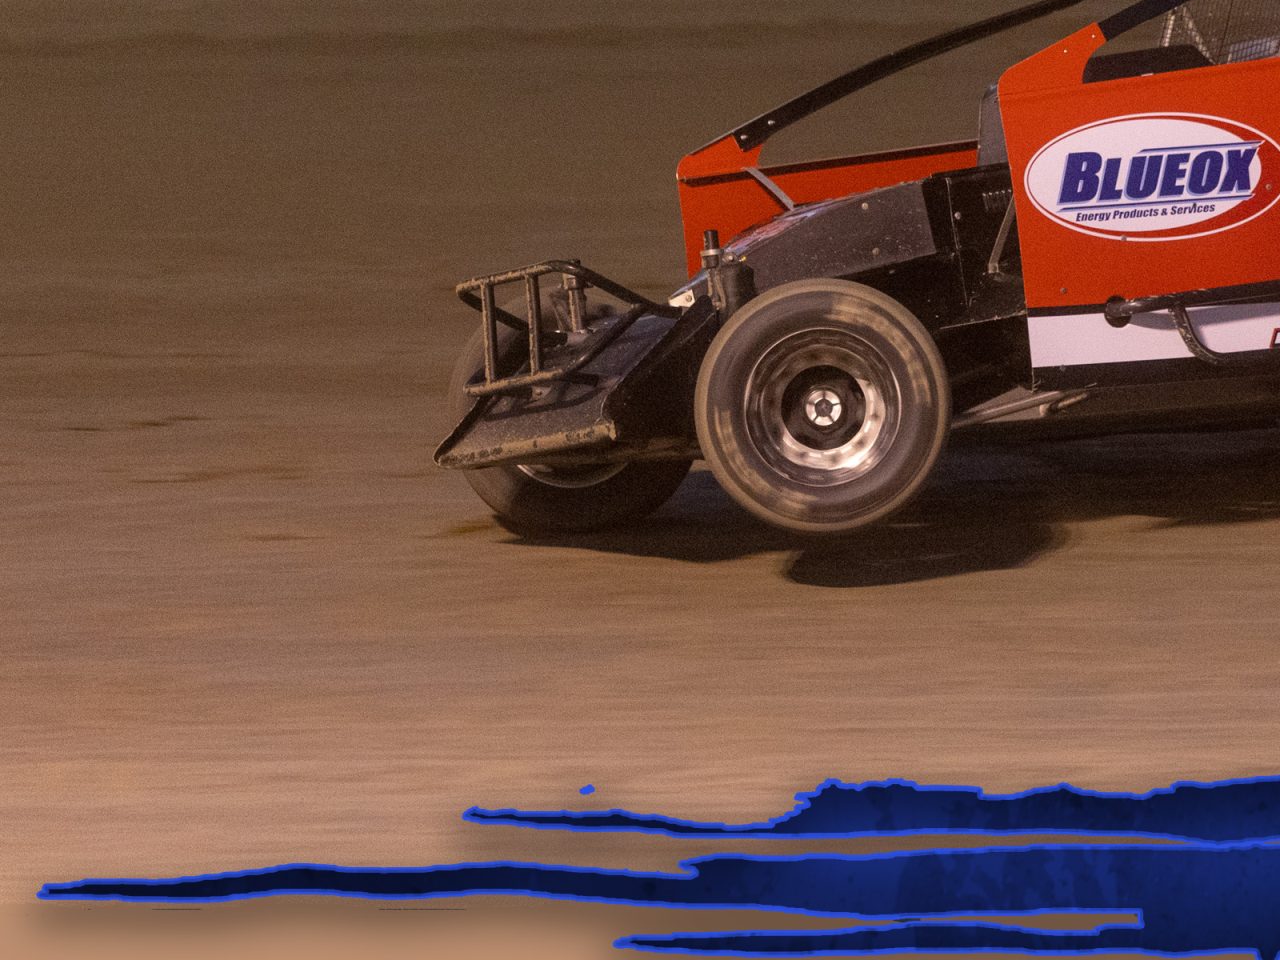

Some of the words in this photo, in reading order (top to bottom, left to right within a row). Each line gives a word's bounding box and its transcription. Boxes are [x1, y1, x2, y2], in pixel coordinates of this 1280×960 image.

[1076, 211, 1111, 222] Energy
[1112, 207, 1159, 220] Products
[1161, 208, 1167, 216] &
[1170, 203, 1216, 216] Services
